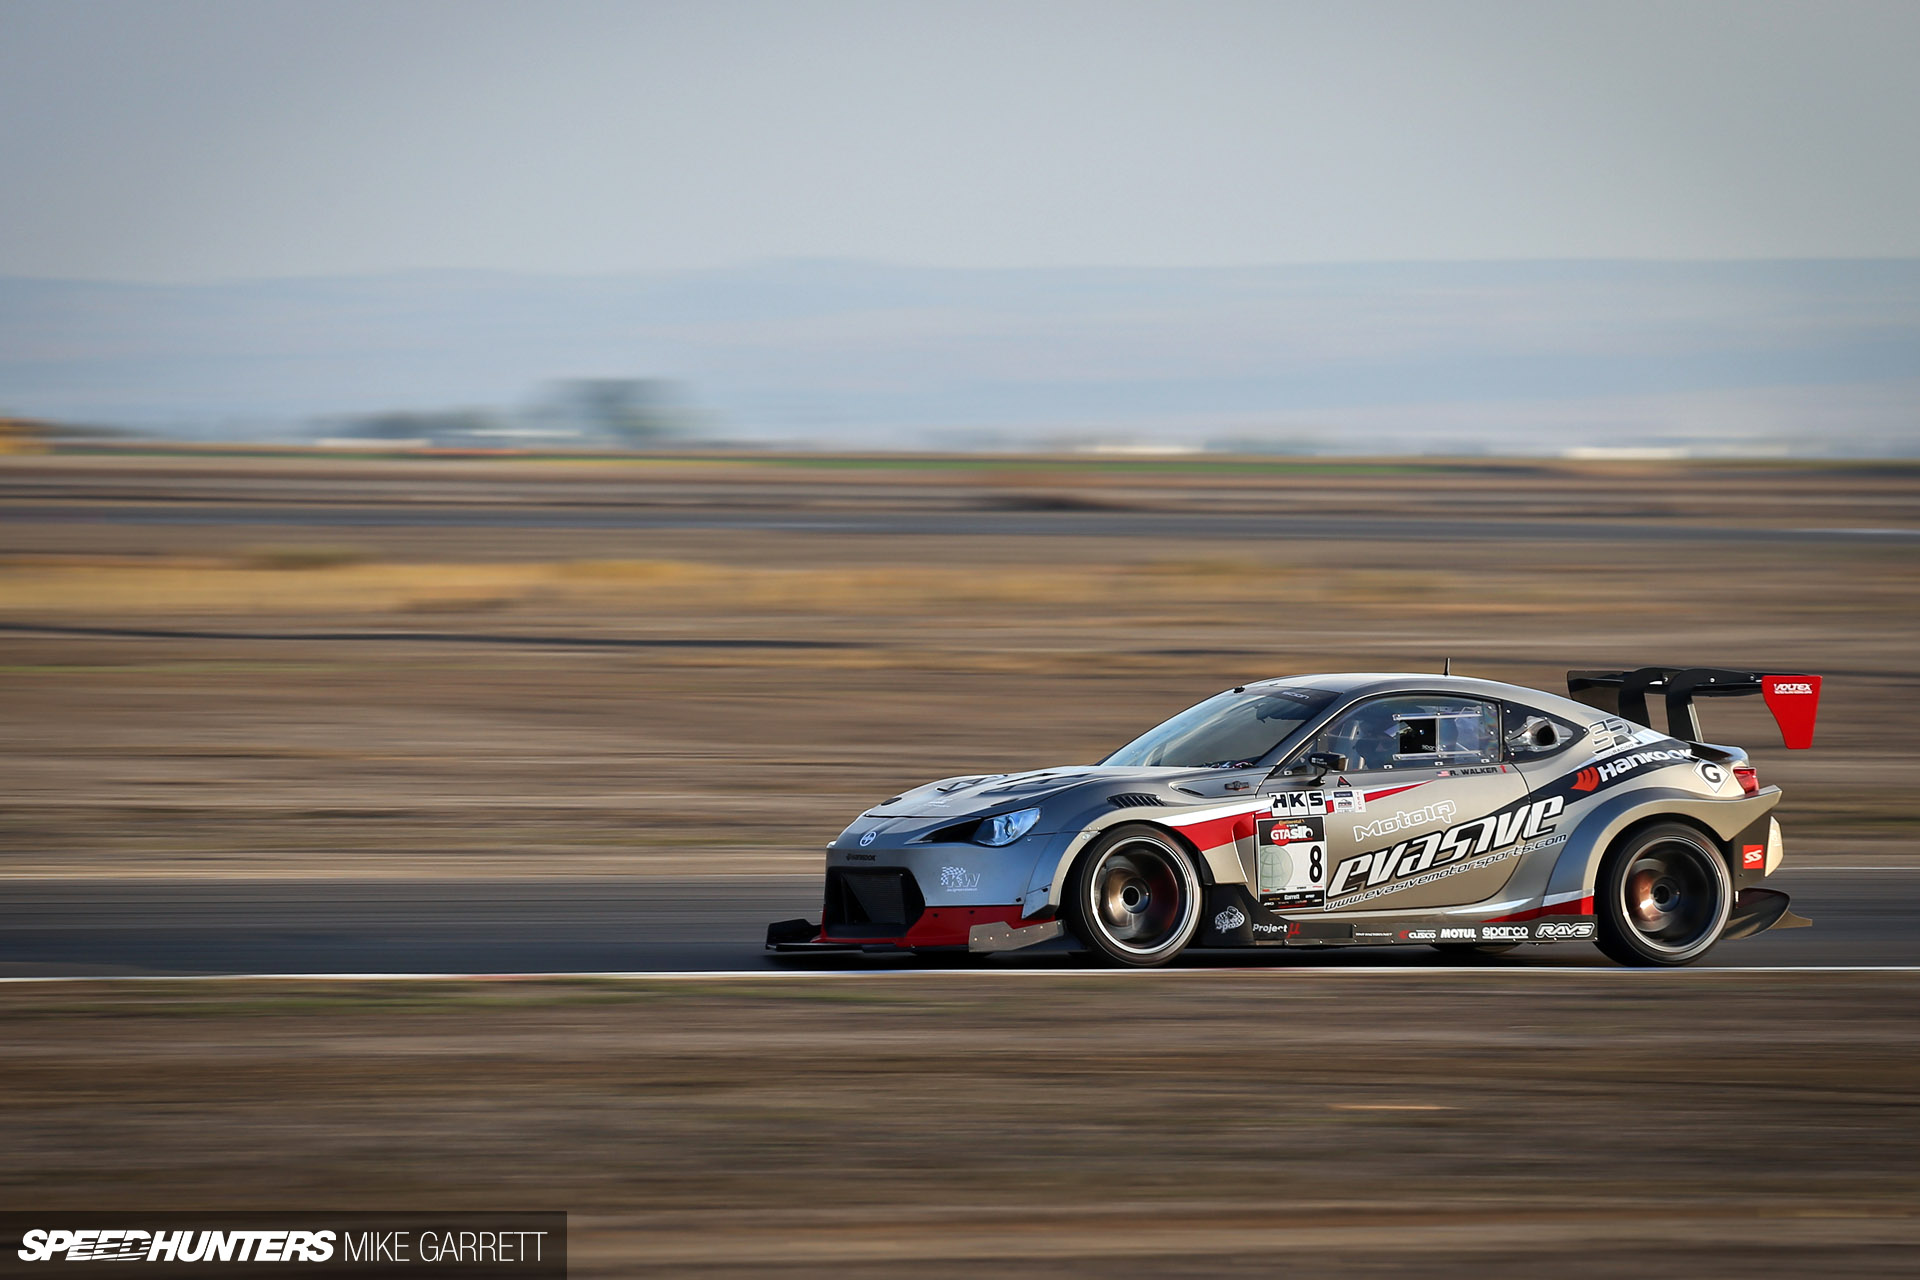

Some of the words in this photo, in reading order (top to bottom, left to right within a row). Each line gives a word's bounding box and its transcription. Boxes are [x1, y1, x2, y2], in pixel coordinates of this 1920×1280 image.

[1773, 683, 1812, 691] VOLTEX
[1460, 767, 1498, 775] WALKER
[1598, 748, 1698, 782] Hankook
[1701, 763, 1721, 783] G
[1271, 792, 1323, 808] HKS
[1309, 845, 1323, 883] 8
[1324, 834, 1567, 911] www.evasivemotorsports.com
[1253, 923, 1288, 934] Project
[1441, 928, 1476, 938] MOTUL
[1482, 926, 1529, 939] sparco
[1535, 922, 1595, 938] RAYS
